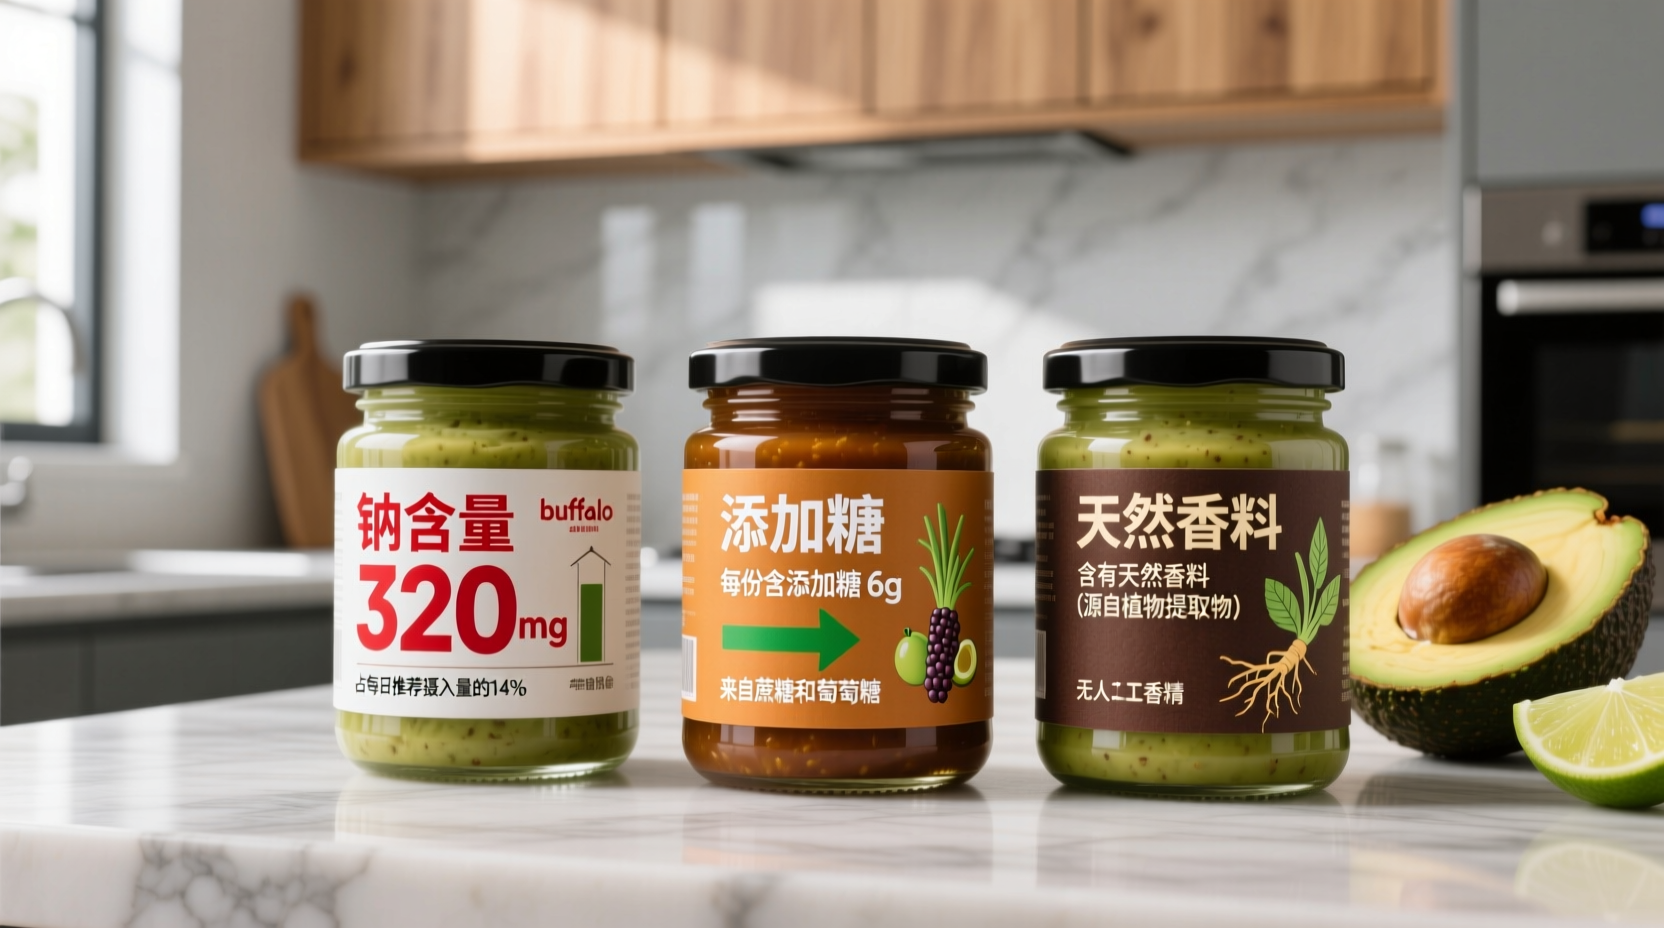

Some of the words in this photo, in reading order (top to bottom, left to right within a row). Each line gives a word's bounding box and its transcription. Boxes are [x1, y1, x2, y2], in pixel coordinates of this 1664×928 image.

[357, 491, 514, 553] 钠含量
[540, 497, 614, 522] buffalo
[720, 493, 885, 554] 添加糖
[1076, 492, 1283, 551] 天然香料
[720, 567, 861, 599] 每份含添加糖
[866, 570, 903, 605] 6g
[1077, 560, 1211, 589] 含有天然香料
